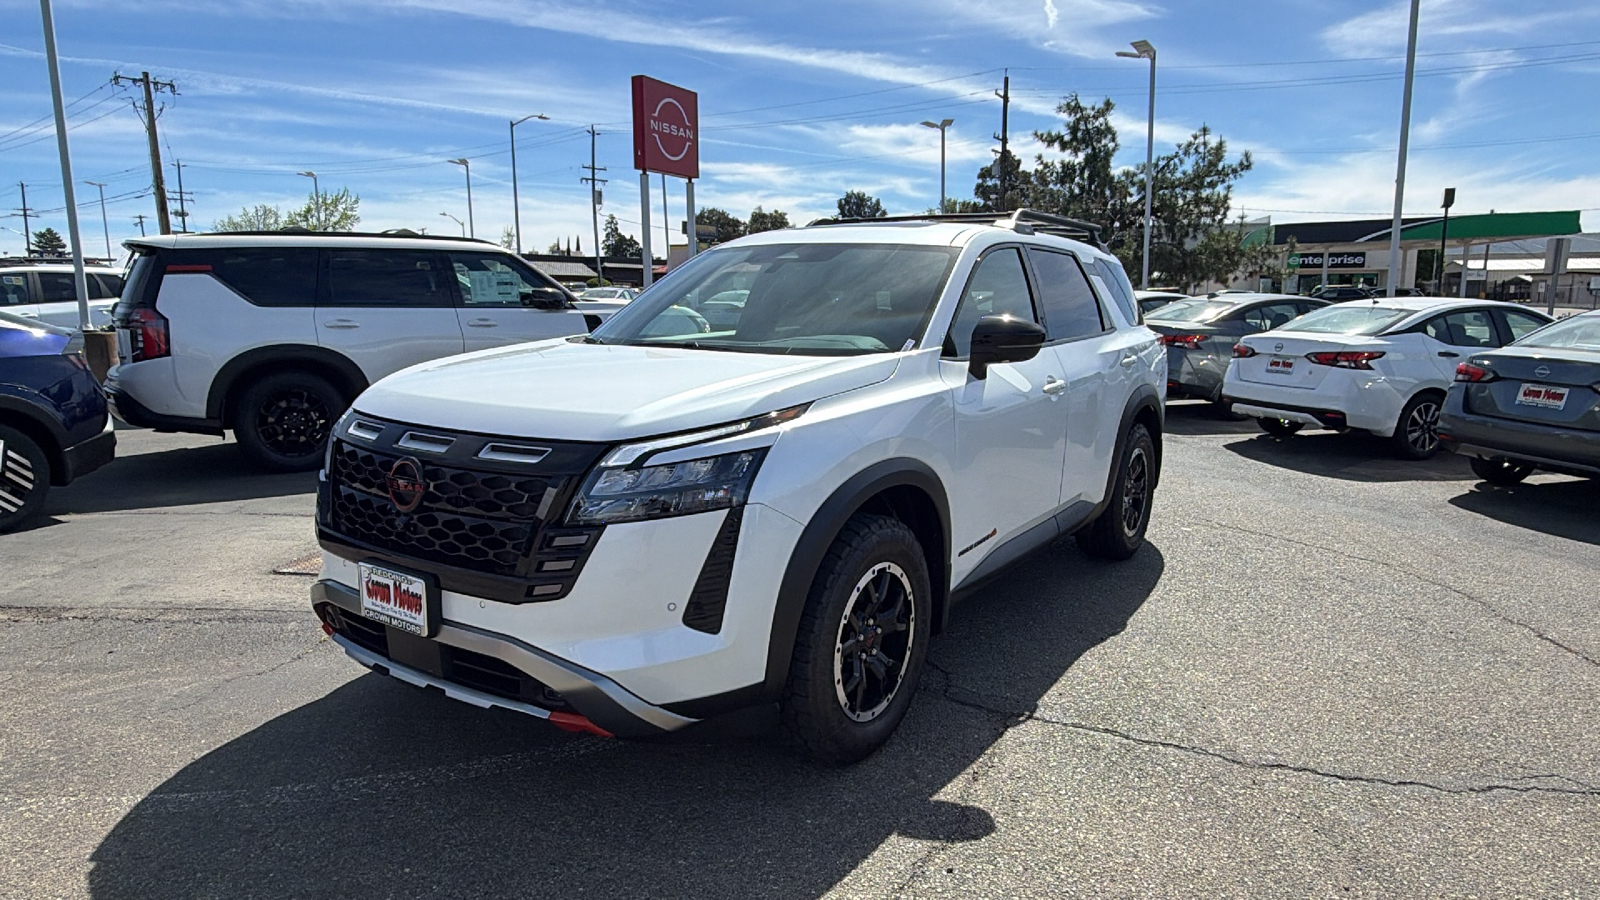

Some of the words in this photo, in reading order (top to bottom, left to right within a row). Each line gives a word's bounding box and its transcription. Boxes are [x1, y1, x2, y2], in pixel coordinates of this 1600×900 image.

[650, 119, 693, 139] NISSAN
[1288, 254, 1364, 266] enteprise
[365, 576, 391, 605] Crown
[392, 580, 422, 616] Motors
[364, 609, 391, 623] CROWN
[391, 617, 421, 634] MOTORS
